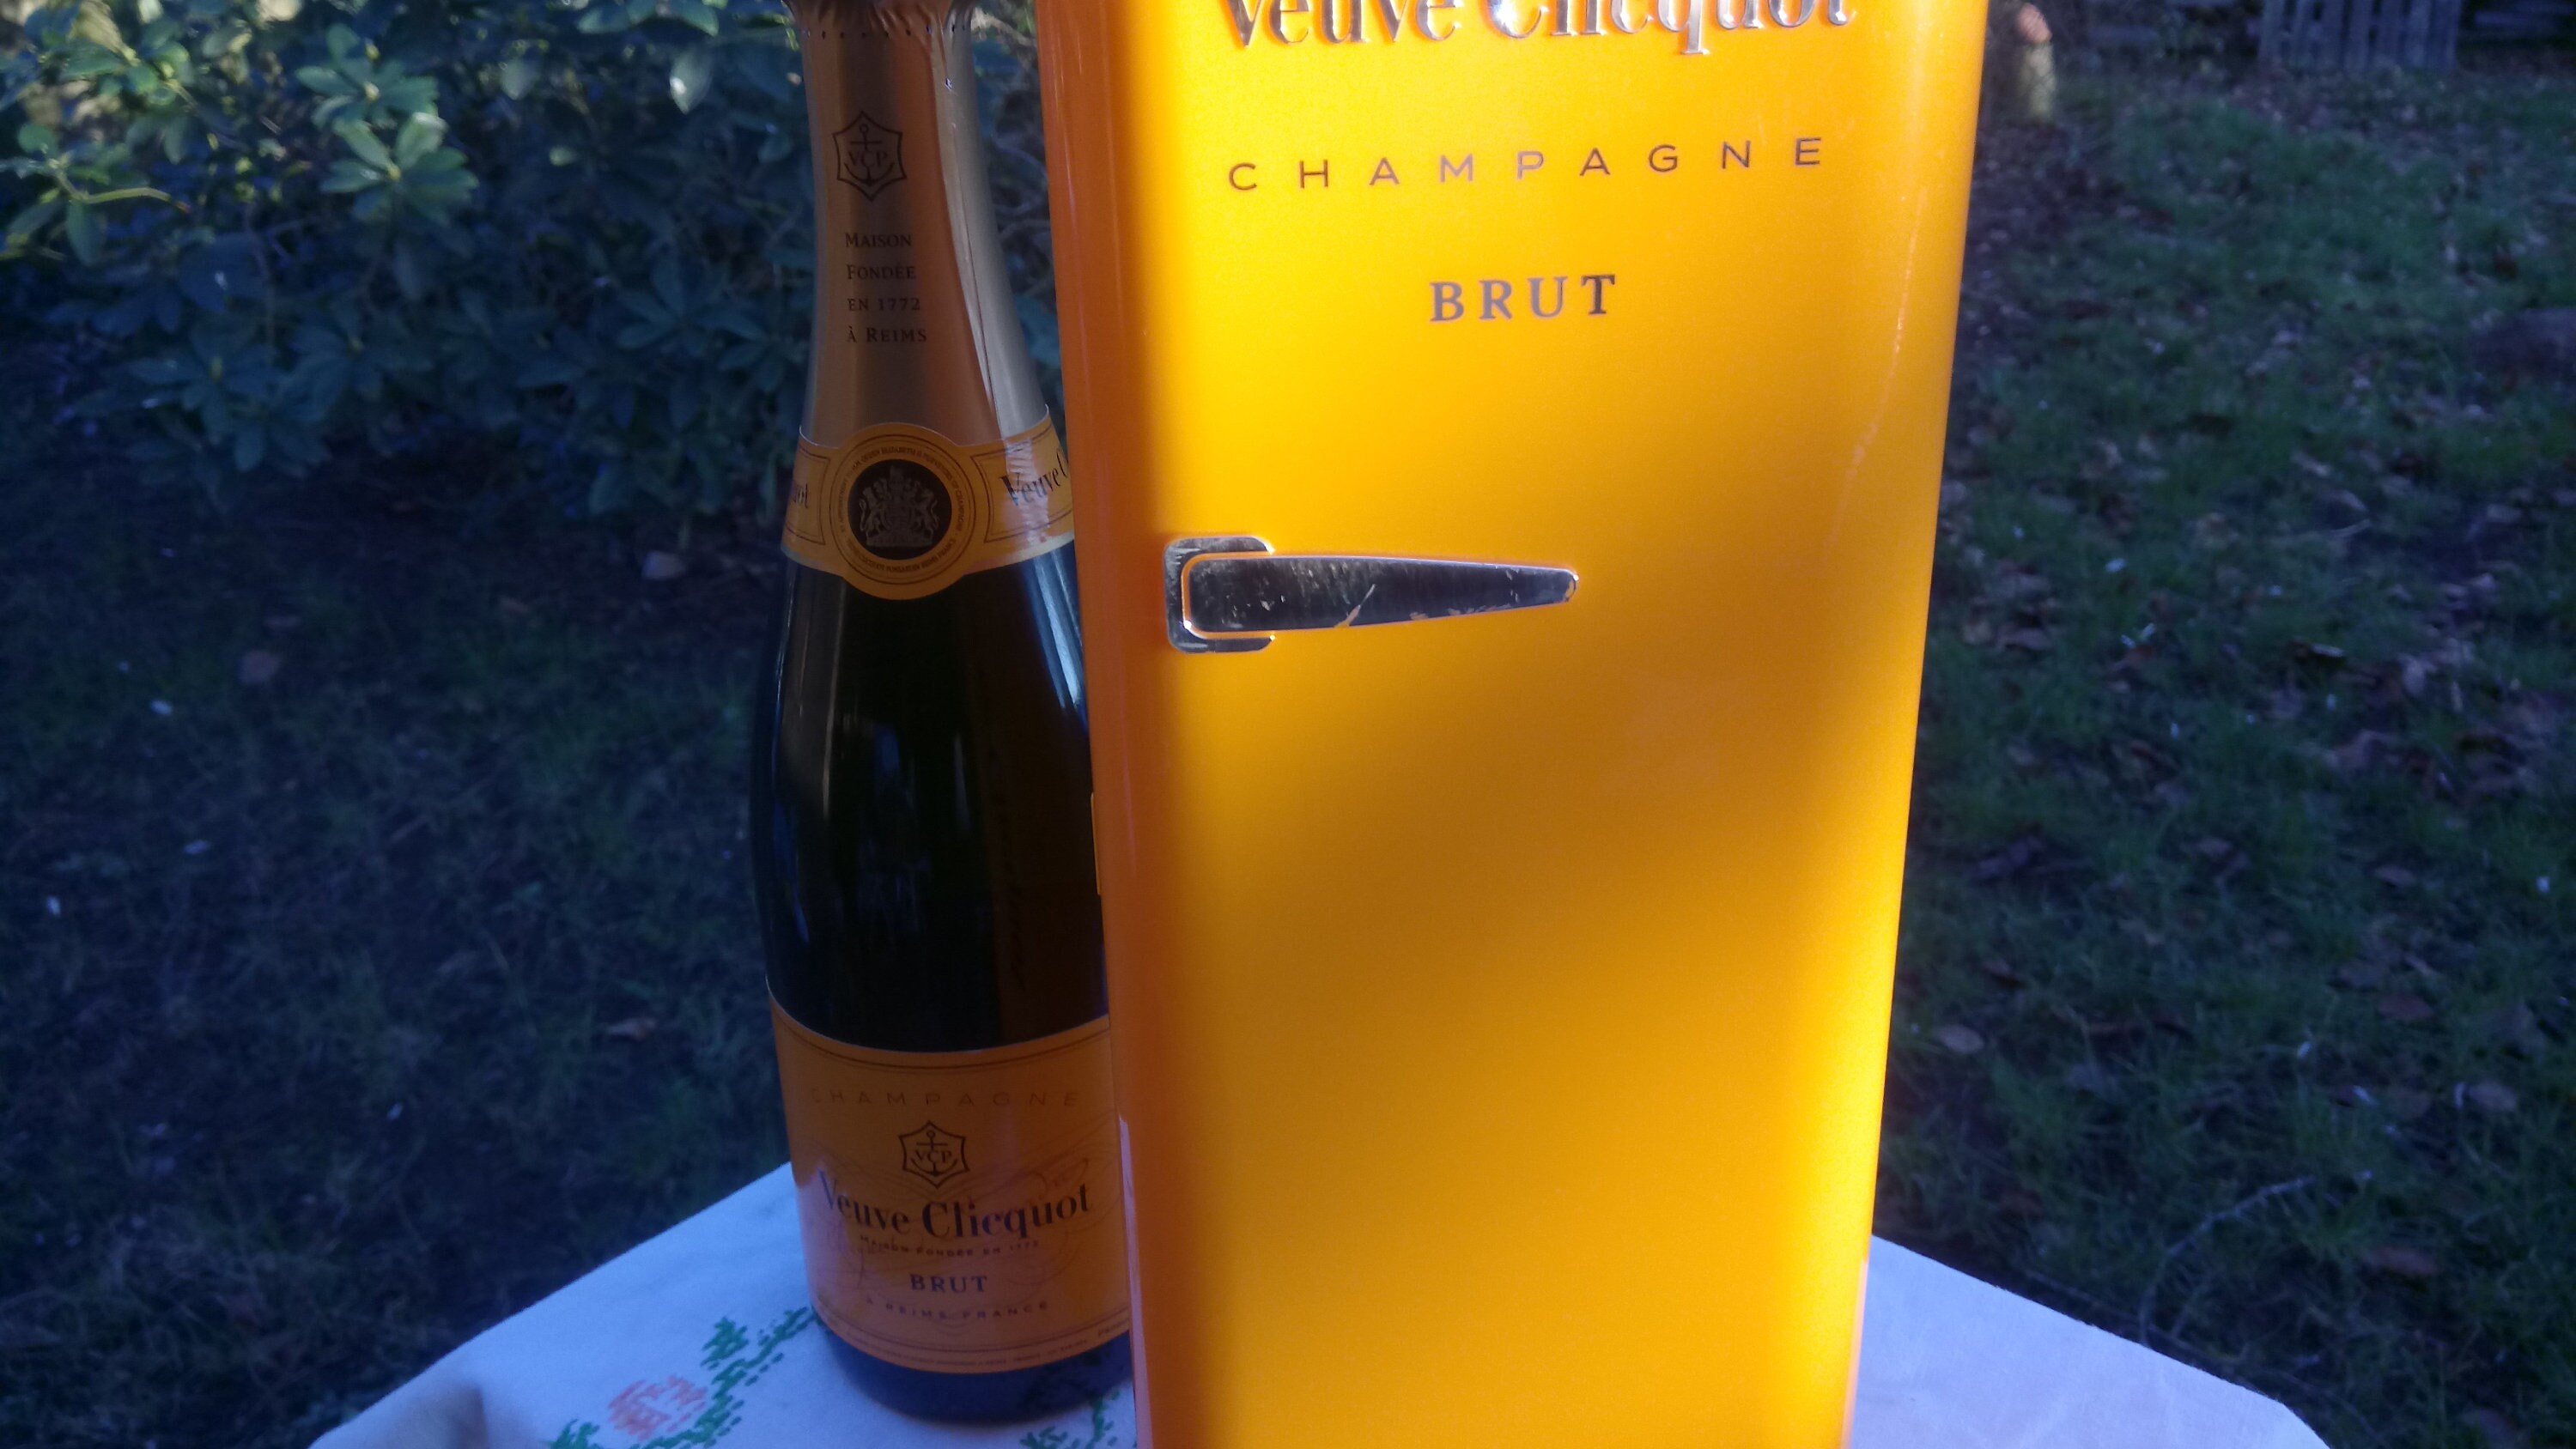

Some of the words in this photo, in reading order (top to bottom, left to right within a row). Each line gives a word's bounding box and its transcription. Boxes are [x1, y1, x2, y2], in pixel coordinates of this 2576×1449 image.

[1228, 136, 1823, 192] CHAMPAGNE
[845, 232, 913, 248] MAISON
[848, 297, 869, 311] EN
[878, 296, 920, 311] 1772
[1429, 273, 1617, 324] BRUT
[866, 327, 927, 343] REIMS
[811, 1088, 1080, 1107] CHAMPAGNE
[818, 1171, 909, 1234] Veuve
[921, 1184, 1091, 1239] Clicquot
[909, 1273, 988, 1293] BRUT
[962, 1300, 1048, 1319] FRANCE
